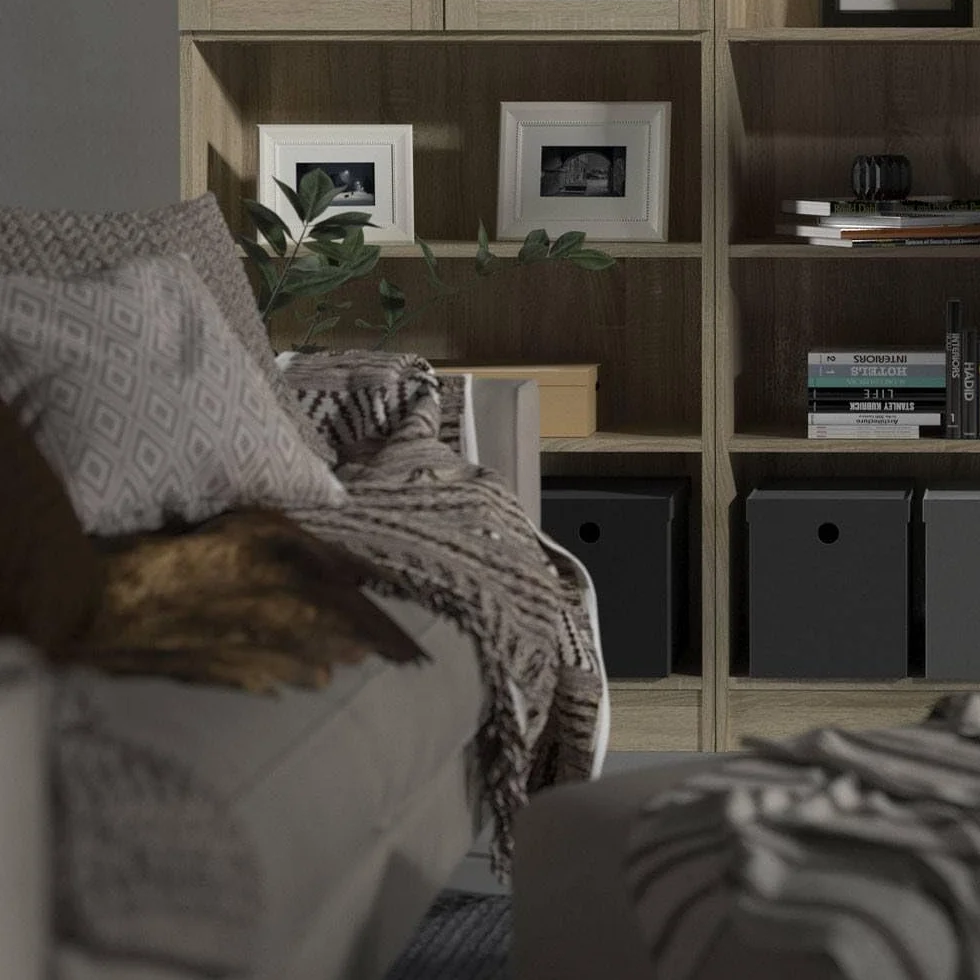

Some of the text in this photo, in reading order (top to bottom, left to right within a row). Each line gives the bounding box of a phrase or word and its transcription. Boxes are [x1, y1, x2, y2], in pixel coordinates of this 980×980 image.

[854, 355, 907, 364] INTERIORS
[951, 333, 960, 379] INTERIORS
[851, 366, 908, 376] HOTELS
[963, 362, 975, 401] HADID
[863, 389, 894, 399] LIFE
[849, 402, 915, 410] STANLEY KUBRICK
